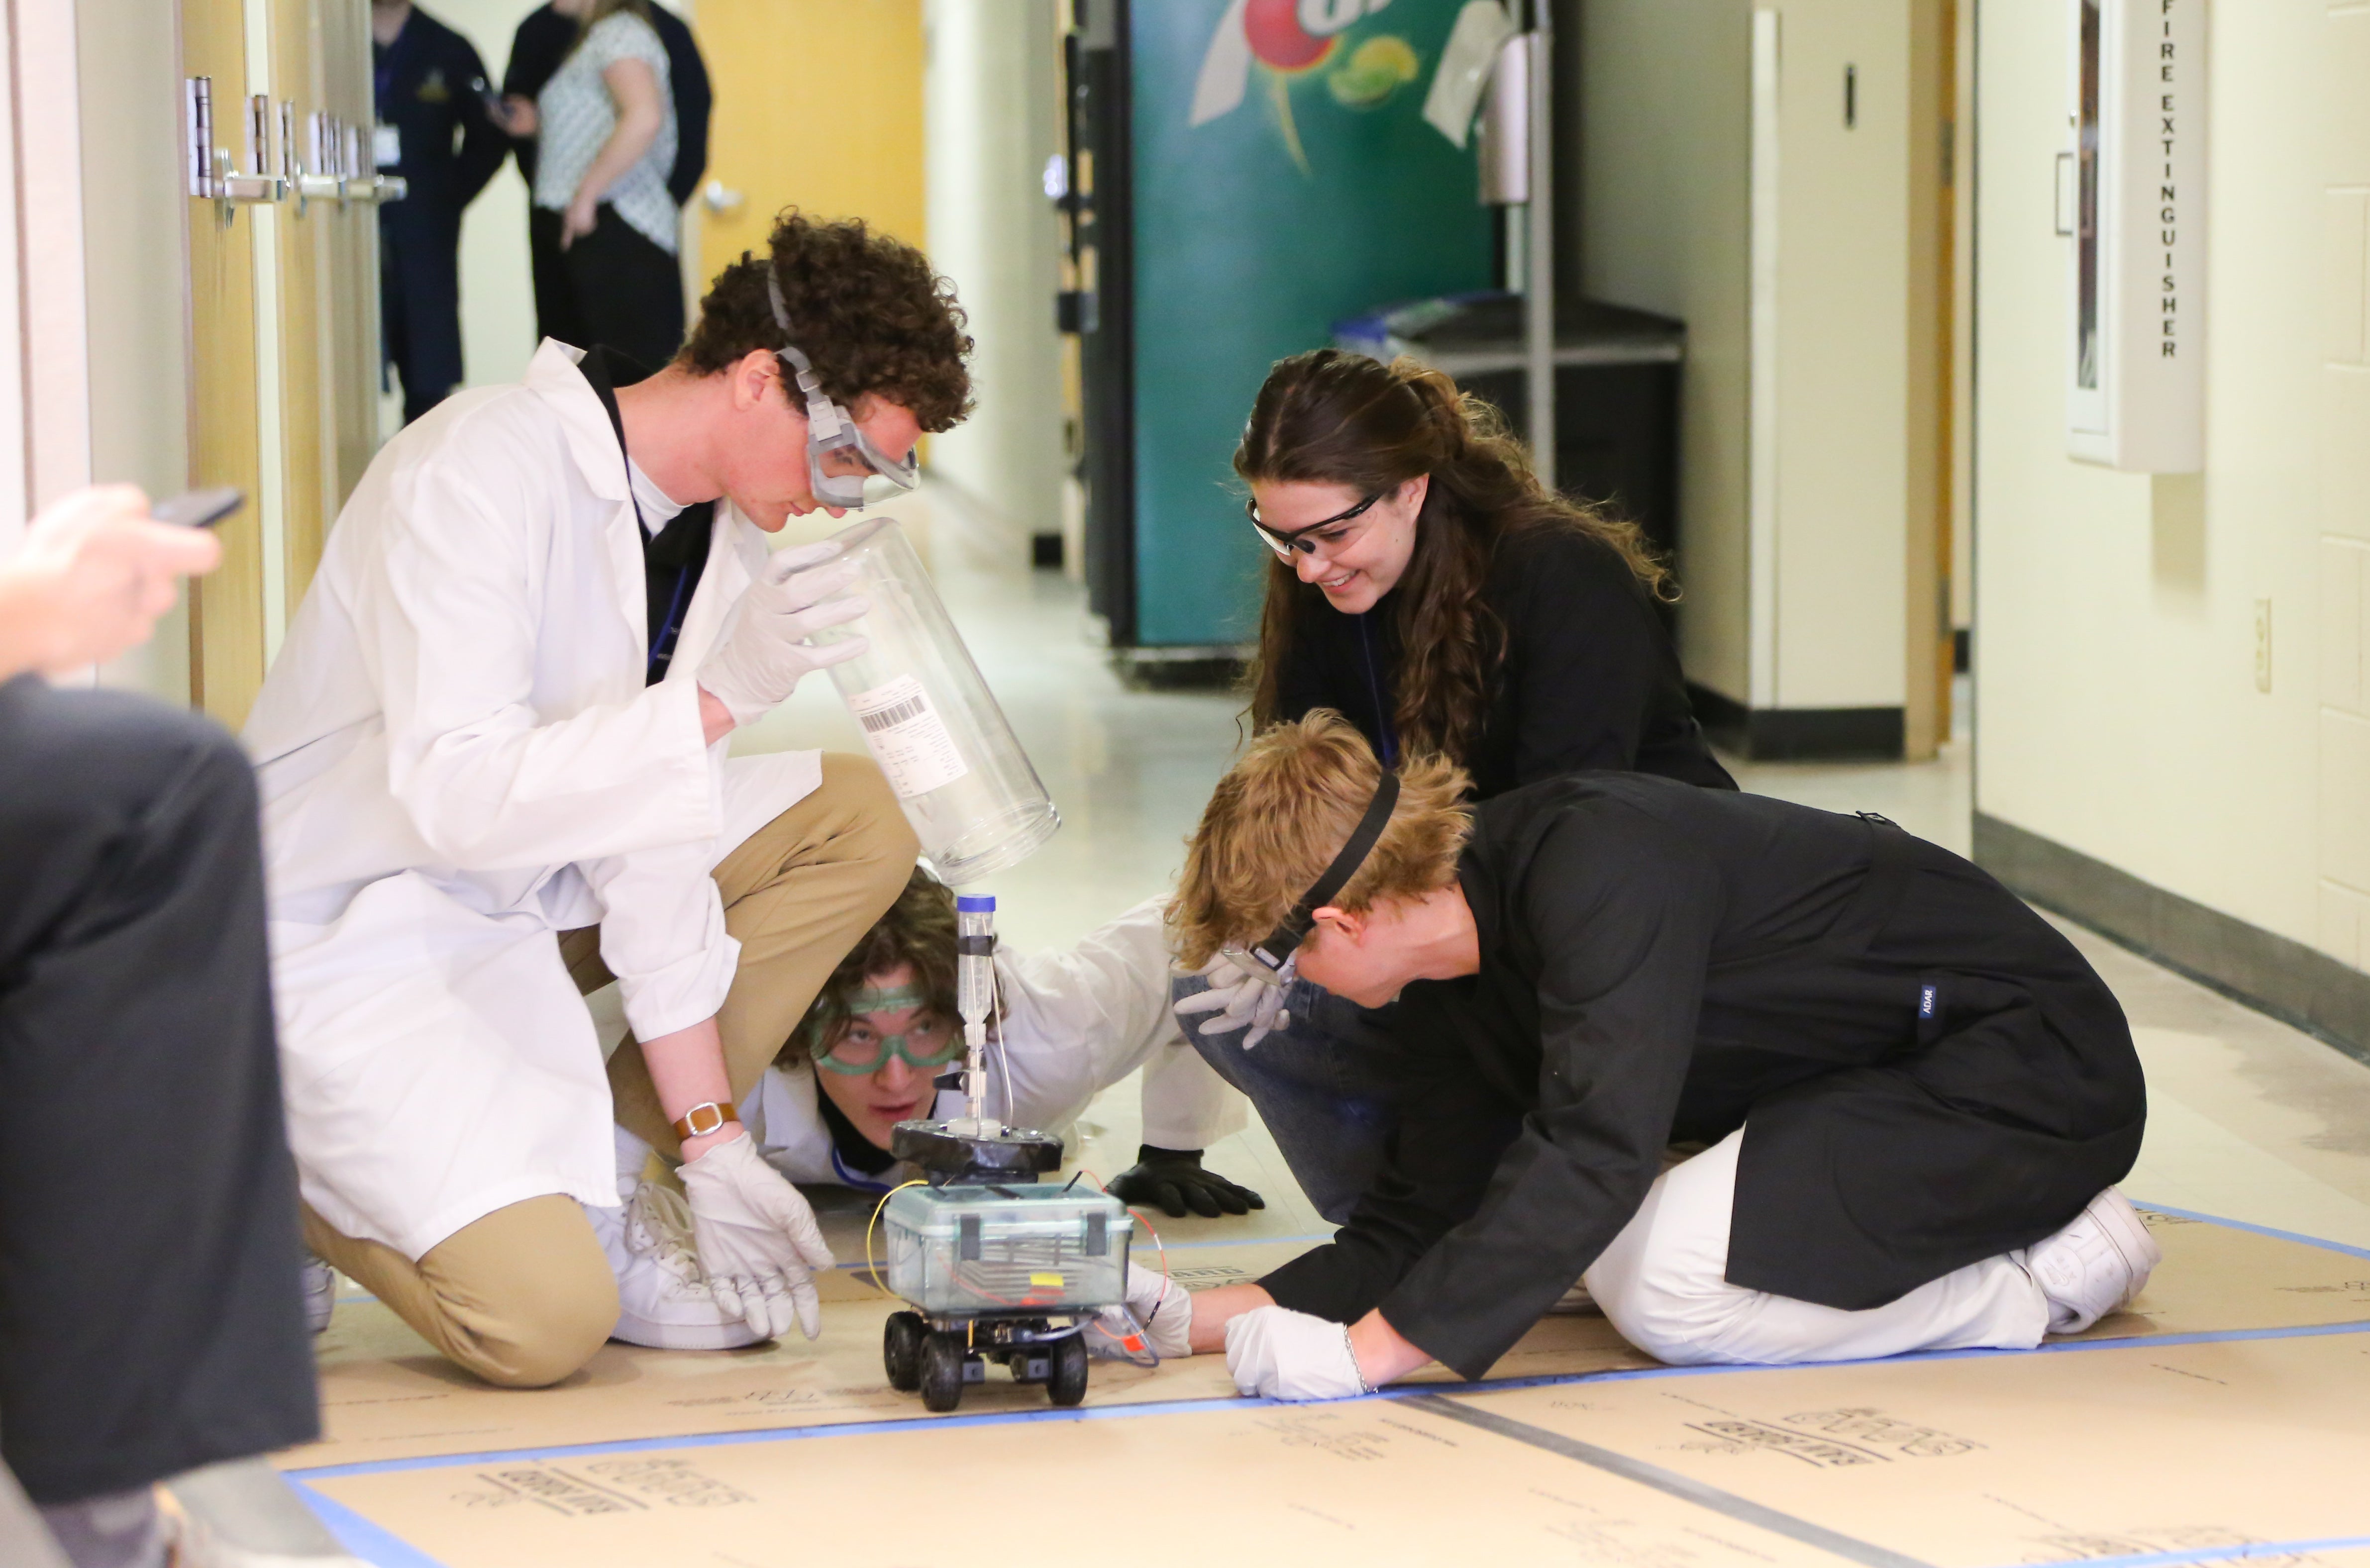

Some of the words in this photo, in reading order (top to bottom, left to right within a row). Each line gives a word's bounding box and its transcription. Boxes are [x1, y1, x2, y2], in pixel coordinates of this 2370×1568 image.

[2161, 0, 2174, 82] FIRE
[2161, 96, 2176, 358] EXTINGUISHER
[1923, 990, 1933, 1014] ADAR
